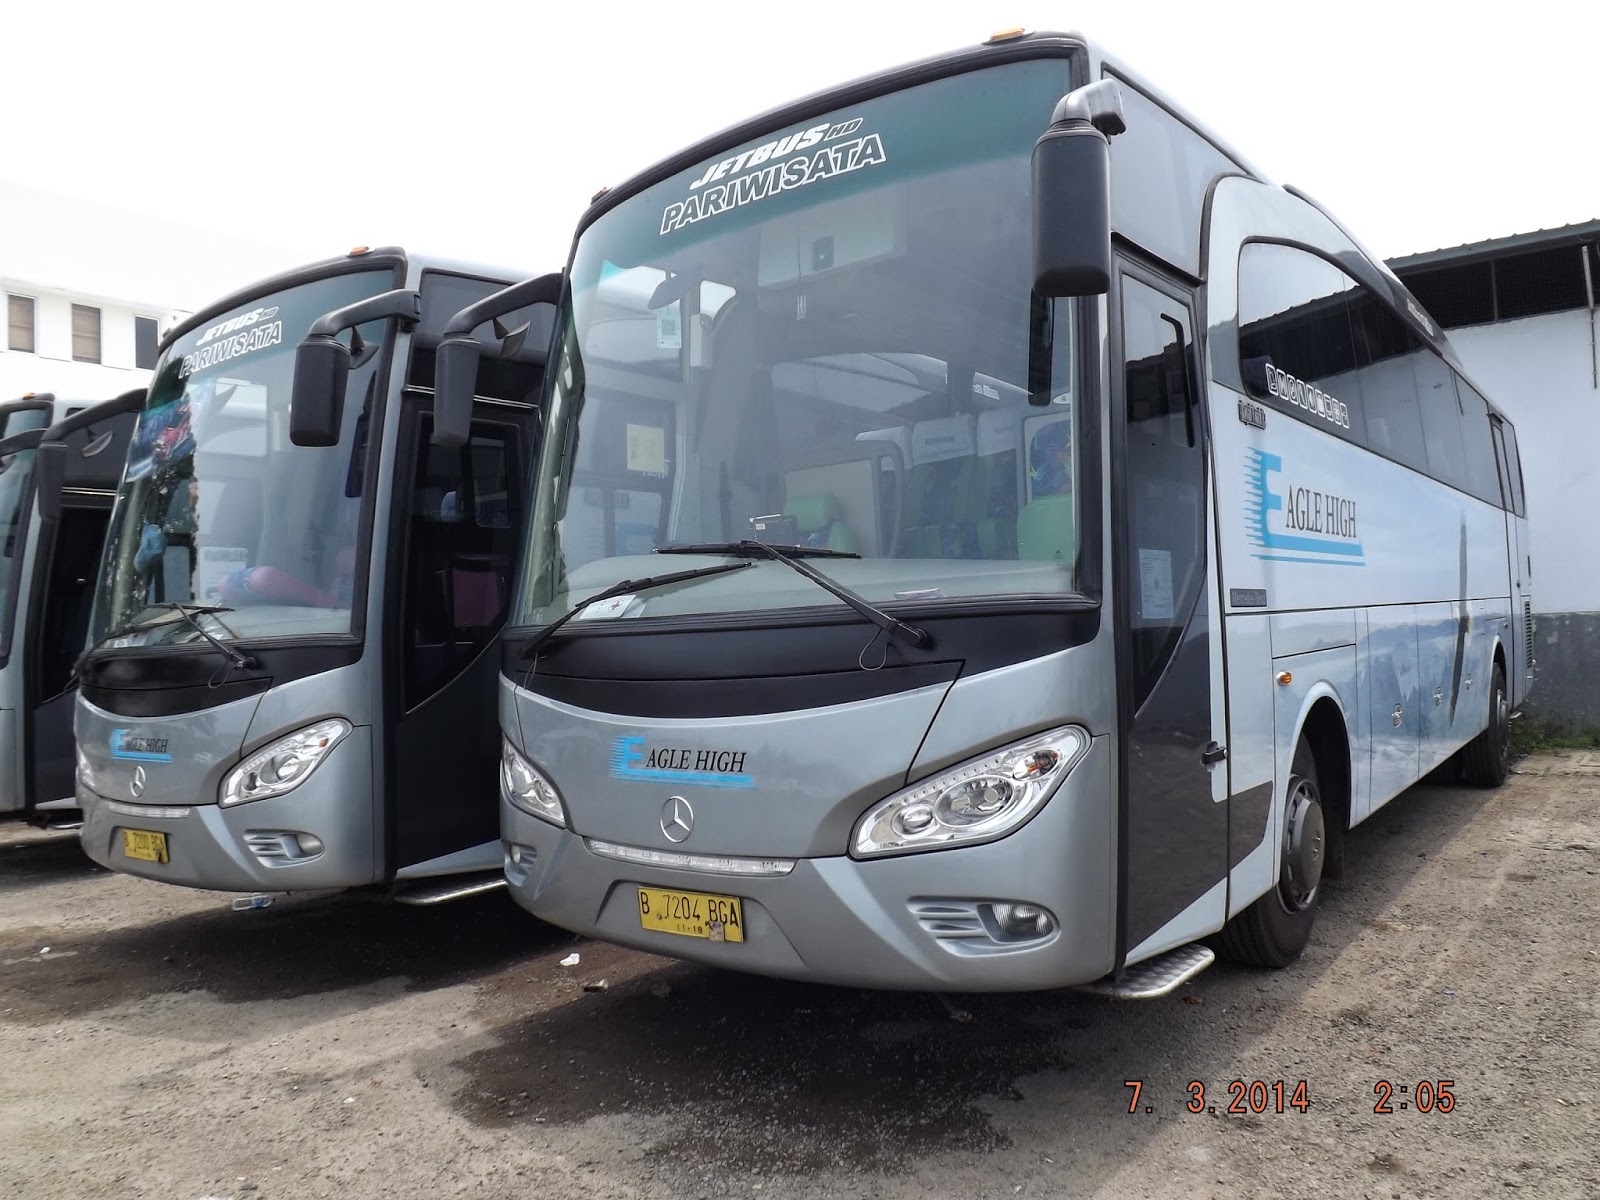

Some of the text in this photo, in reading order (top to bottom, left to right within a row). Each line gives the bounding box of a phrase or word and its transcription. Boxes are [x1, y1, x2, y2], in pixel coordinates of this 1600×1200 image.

[689, 117, 863, 190] JETBUS HD
[660, 133, 887, 236] PARIWISATA
[196, 308, 264, 346] JETBUS
[178, 320, 283, 379] PARIWISATA
[1325, 494, 1357, 538] HIGH
[145, 738, 168, 753] HIGH
[694, 750, 747, 773] HIGH
[640, 891, 740, 928] B 7204 BGA
